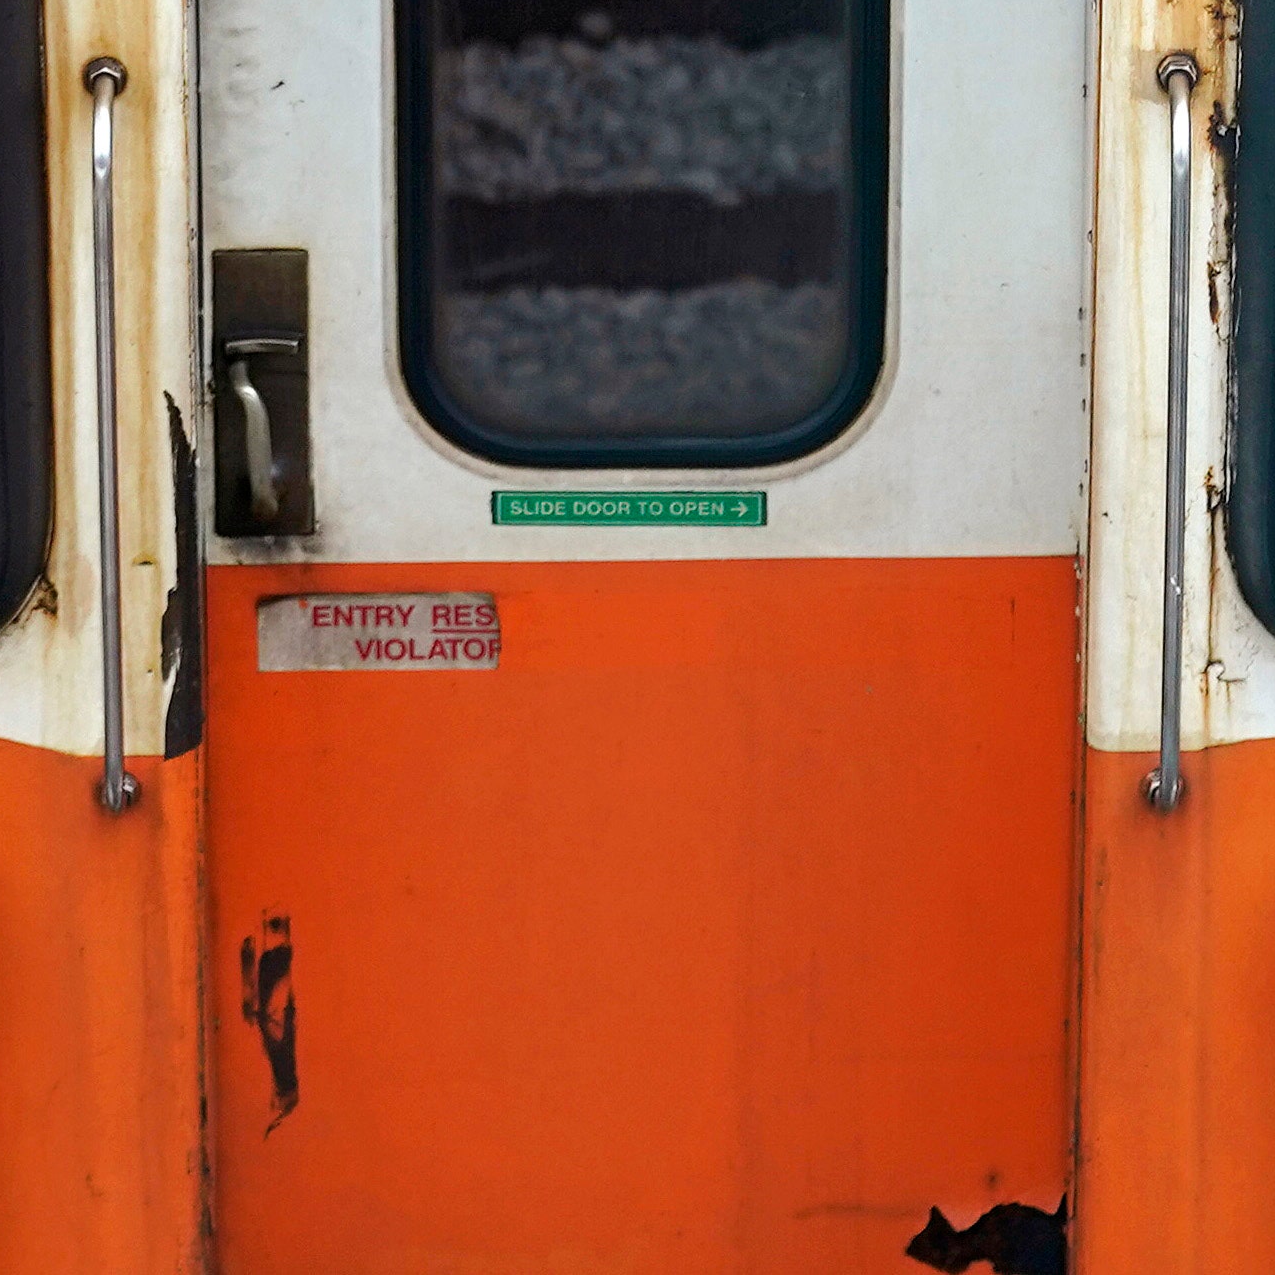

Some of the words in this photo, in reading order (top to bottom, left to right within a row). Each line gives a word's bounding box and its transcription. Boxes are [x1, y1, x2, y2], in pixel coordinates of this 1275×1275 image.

[509, 500, 566, 517] SLIDE
[573, 500, 631, 516] DOOR
[638, 500, 664, 516] TO
[669, 500, 725, 516] OPEN
[311, 604, 416, 627] ENTRY
[431, 603, 497, 627] RES
